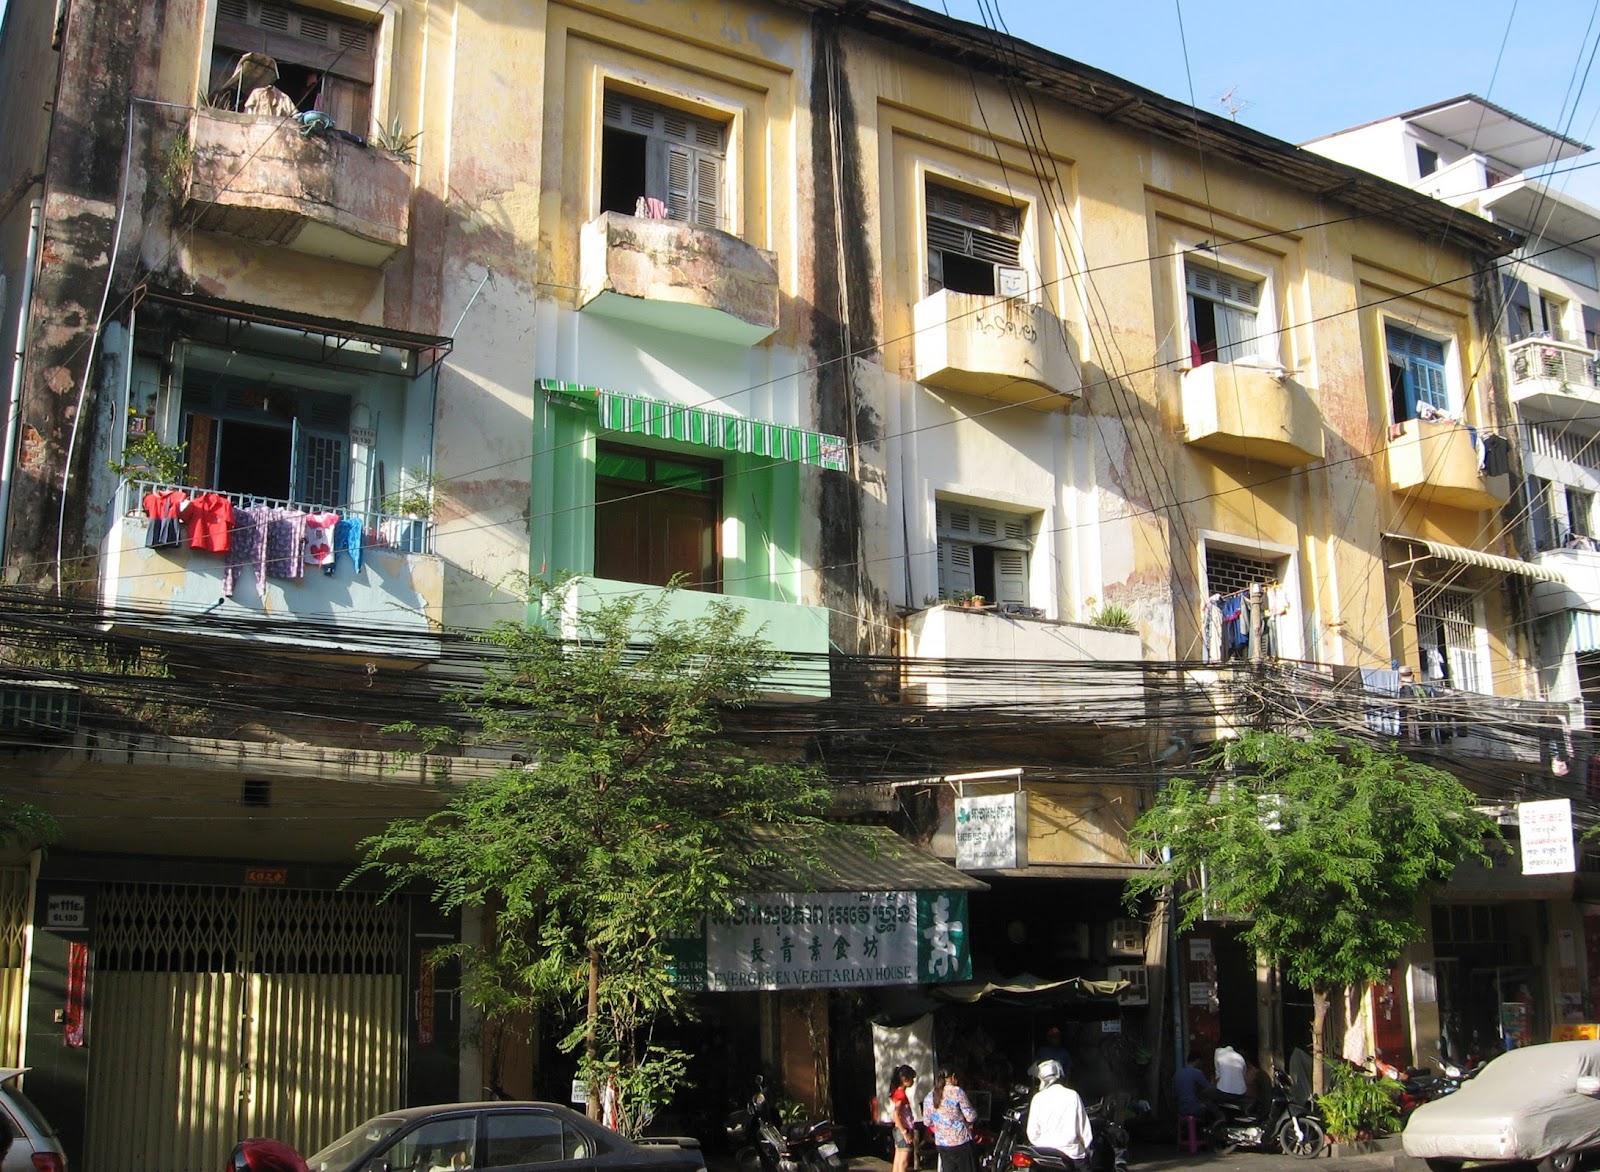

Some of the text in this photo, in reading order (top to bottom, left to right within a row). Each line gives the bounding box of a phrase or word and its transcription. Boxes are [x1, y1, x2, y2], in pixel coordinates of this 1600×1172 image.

[64, 913, 78, 921] 130
[751, 935, 879, 963] 長青素食坊
[714, 965, 912, 987] EVERGREEN VEGETARIAN HOUSE
